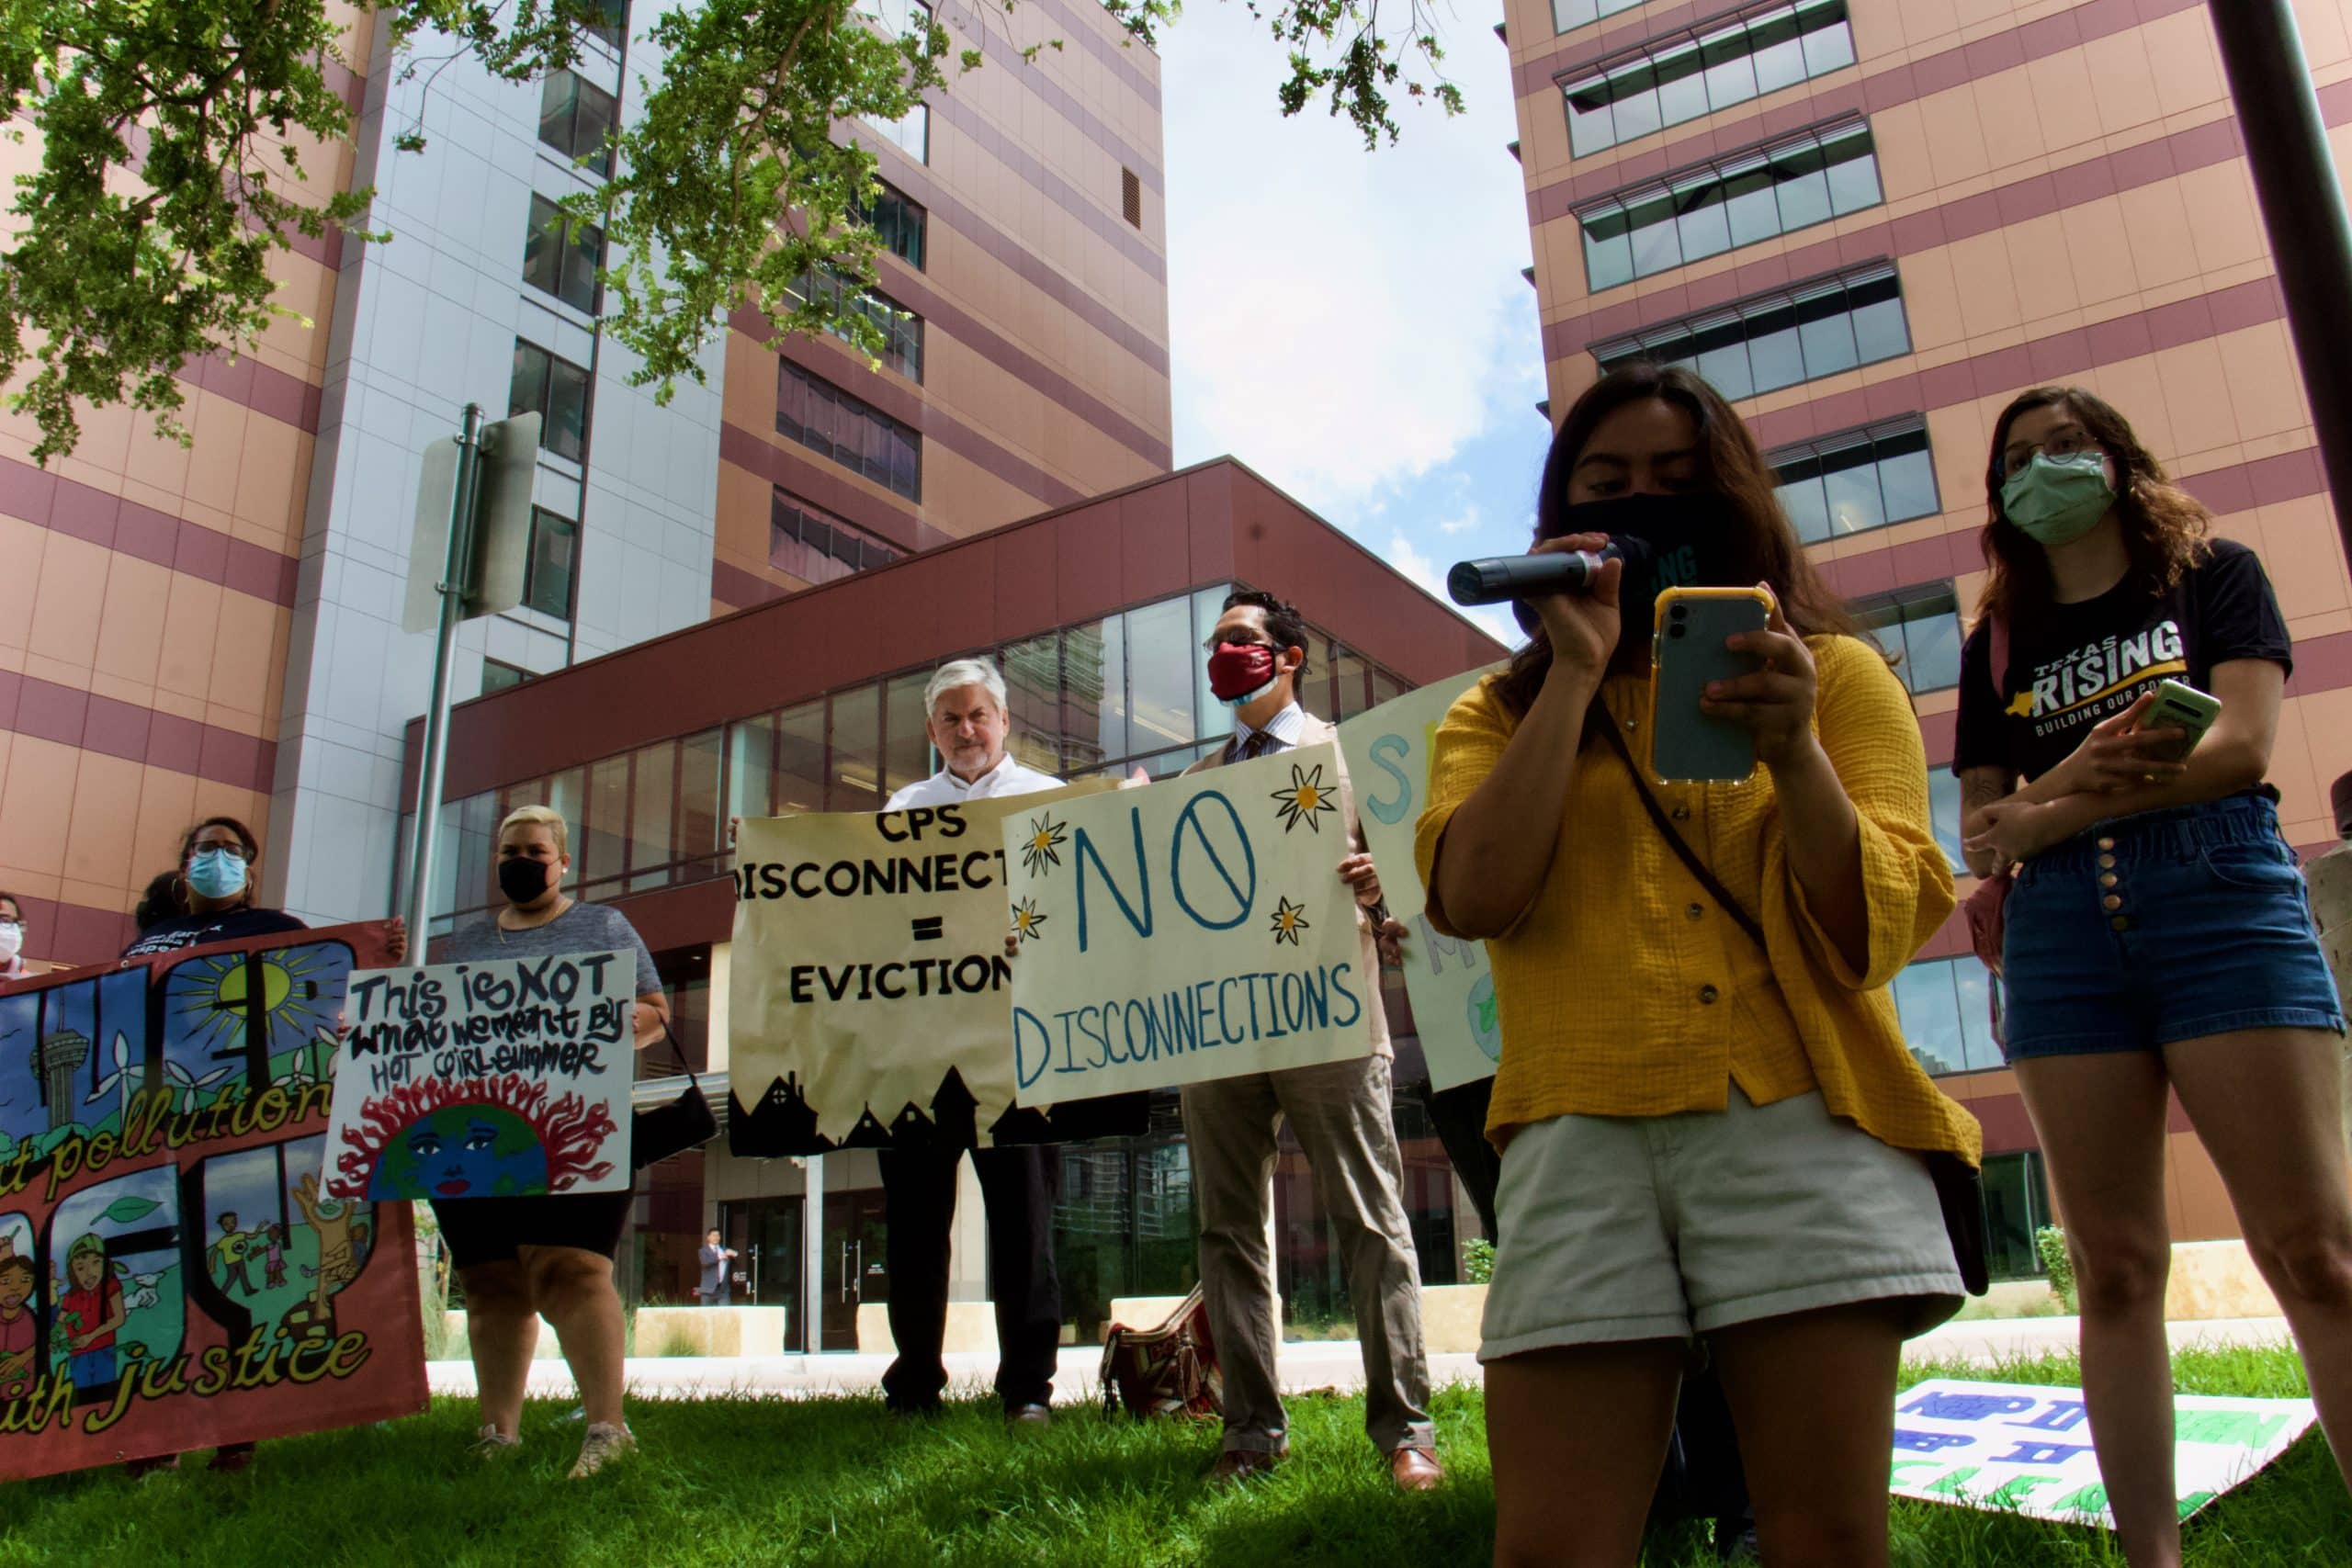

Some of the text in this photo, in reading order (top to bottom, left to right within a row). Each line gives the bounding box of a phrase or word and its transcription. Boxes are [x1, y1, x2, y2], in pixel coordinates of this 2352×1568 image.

[2032, 620, 2184, 718] RISING
[2034, 635, 2118, 678] TEXAS
[2035, 675, 2190, 737] BUILDING OUR POR
[876, 804, 967, 842] CPS
[734, 849, 1007, 902] ISCONNECT
[1075, 790, 1256, 953] NO
[350, 953, 616, 1021] This is NOT
[790, 954, 1012, 1004] EVICTION
[1012, 963, 1361, 1089] DISCONNECTIONS
[371, 1053, 423, 1093] HOT
[43, 1080, 334, 1205] pollution
[85, 1328, 372, 1434] justice
